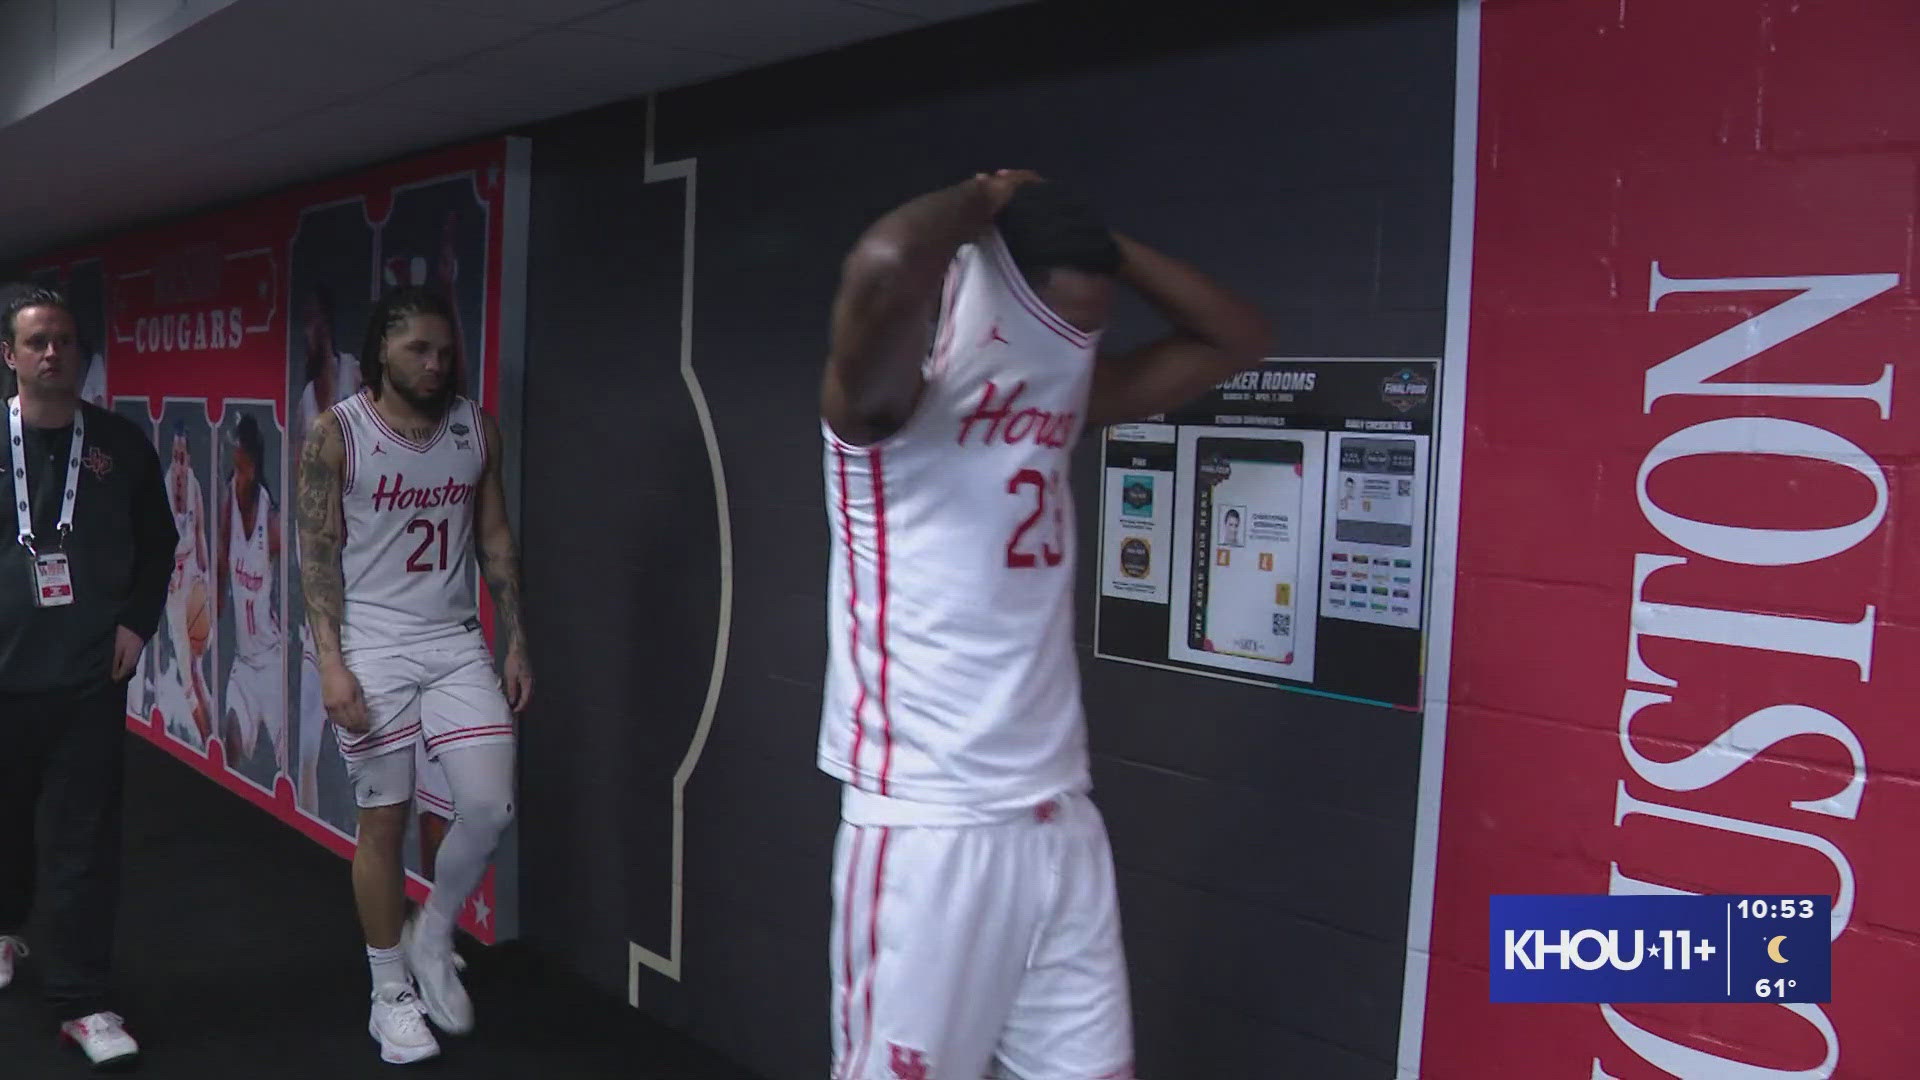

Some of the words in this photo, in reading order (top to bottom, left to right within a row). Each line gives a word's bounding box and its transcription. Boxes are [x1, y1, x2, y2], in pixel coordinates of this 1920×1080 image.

[135, 307, 243, 353] COUGARS
[1261, 371, 1316, 392] ROOMS
[406, 518, 449, 573] 21
[246, 599, 256, 635] 11
[1591, 260, 1900, 1080] OUSTON
